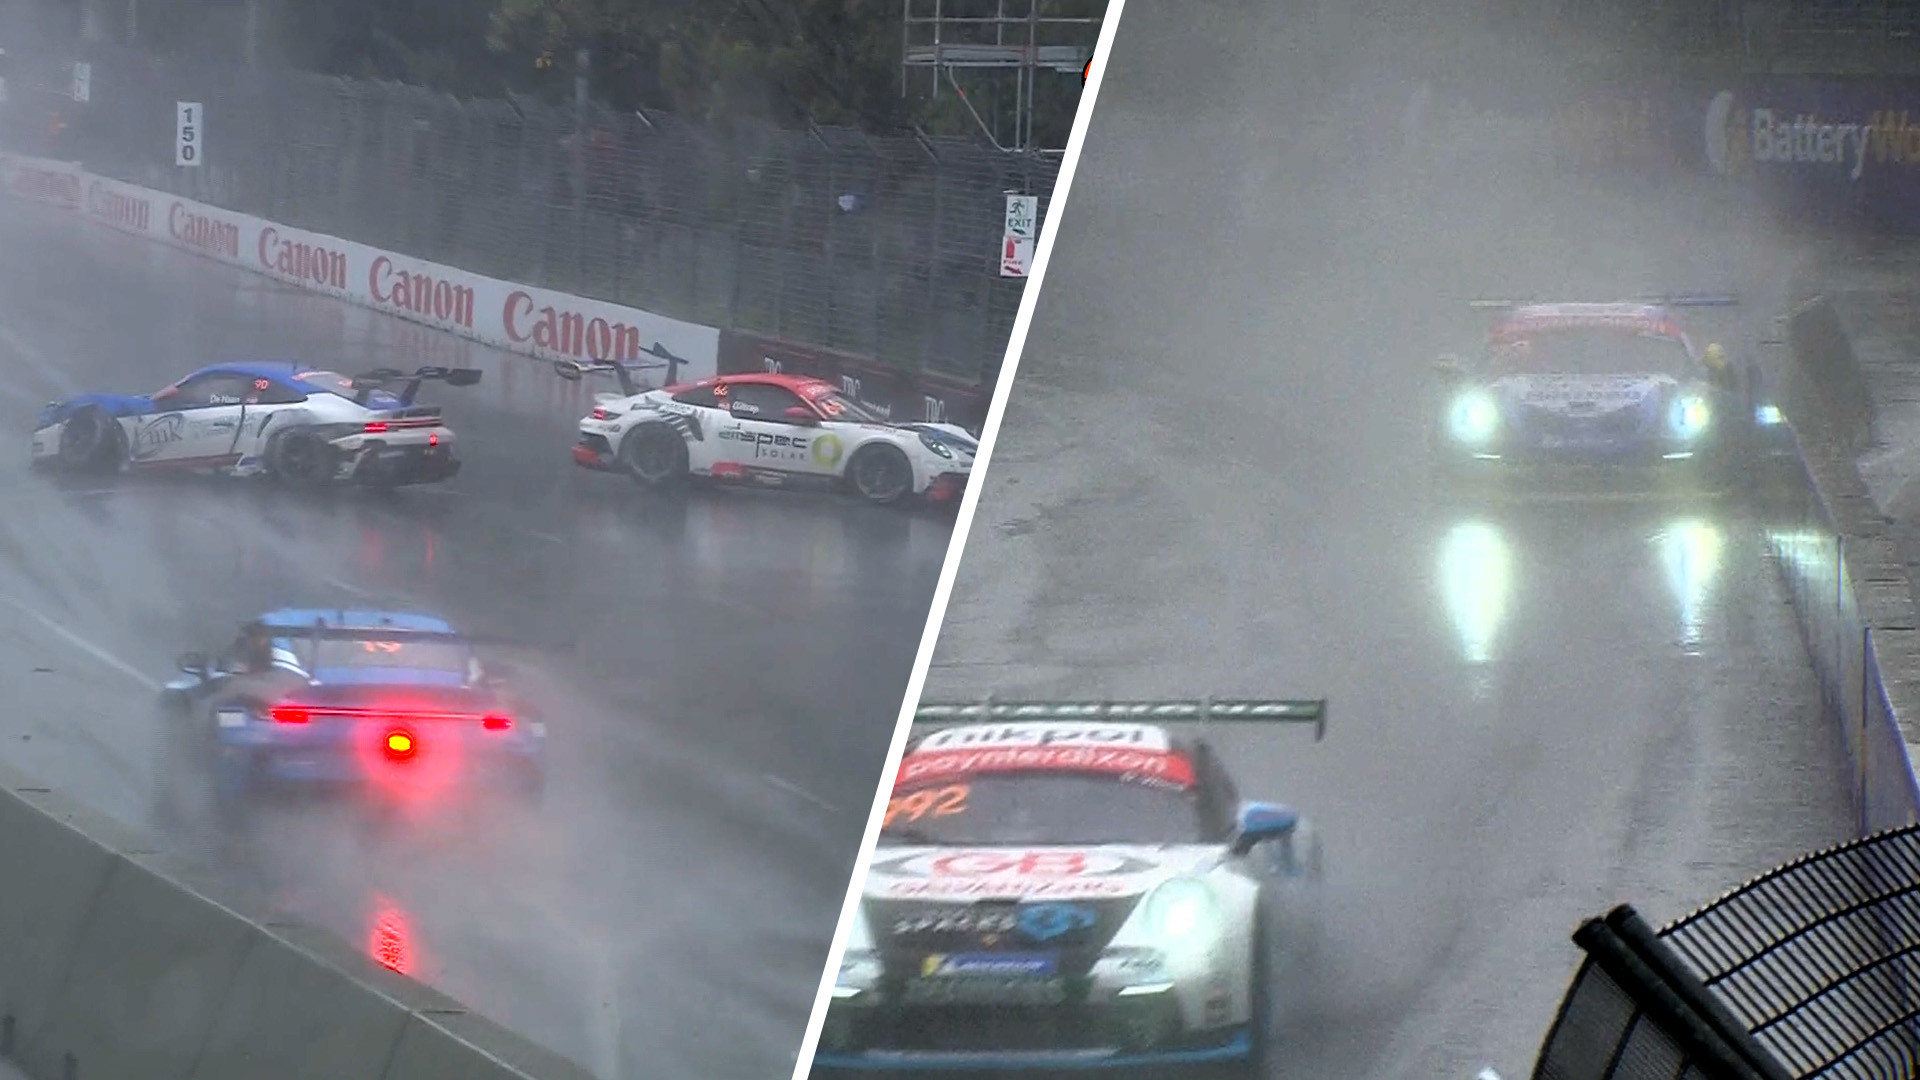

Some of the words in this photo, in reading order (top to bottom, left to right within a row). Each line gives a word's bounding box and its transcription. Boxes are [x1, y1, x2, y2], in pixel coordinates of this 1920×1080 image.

[182, 108, 195, 160] 150
[168, 202, 240, 259] Canon
[1008, 219, 1032, 227] EXIT
[258, 227, 347, 289] Canon
[369, 256, 475, 327] Canon
[503, 291, 640, 361] Canon
